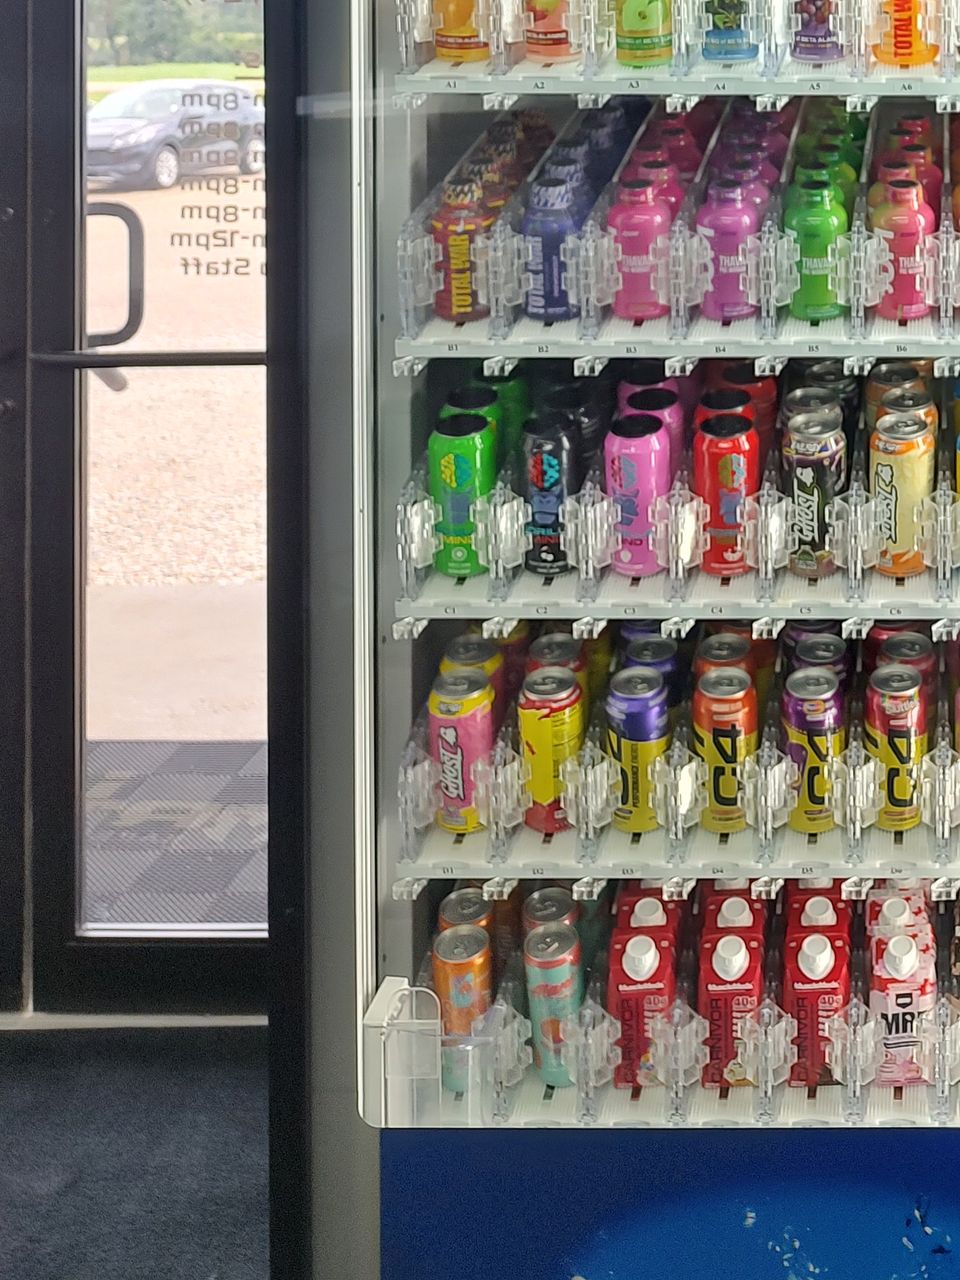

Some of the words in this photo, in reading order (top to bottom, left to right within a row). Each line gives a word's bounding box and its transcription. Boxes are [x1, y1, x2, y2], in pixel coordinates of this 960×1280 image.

[893, 16, 914, 59] TOTAL
[448, 234, 470, 269] WAR
[451, 270, 473, 316] TOTAL
[789, 477, 819, 544] GHOST
[439, 735, 466, 802] GHOST
[712, 723, 742, 807] C4
